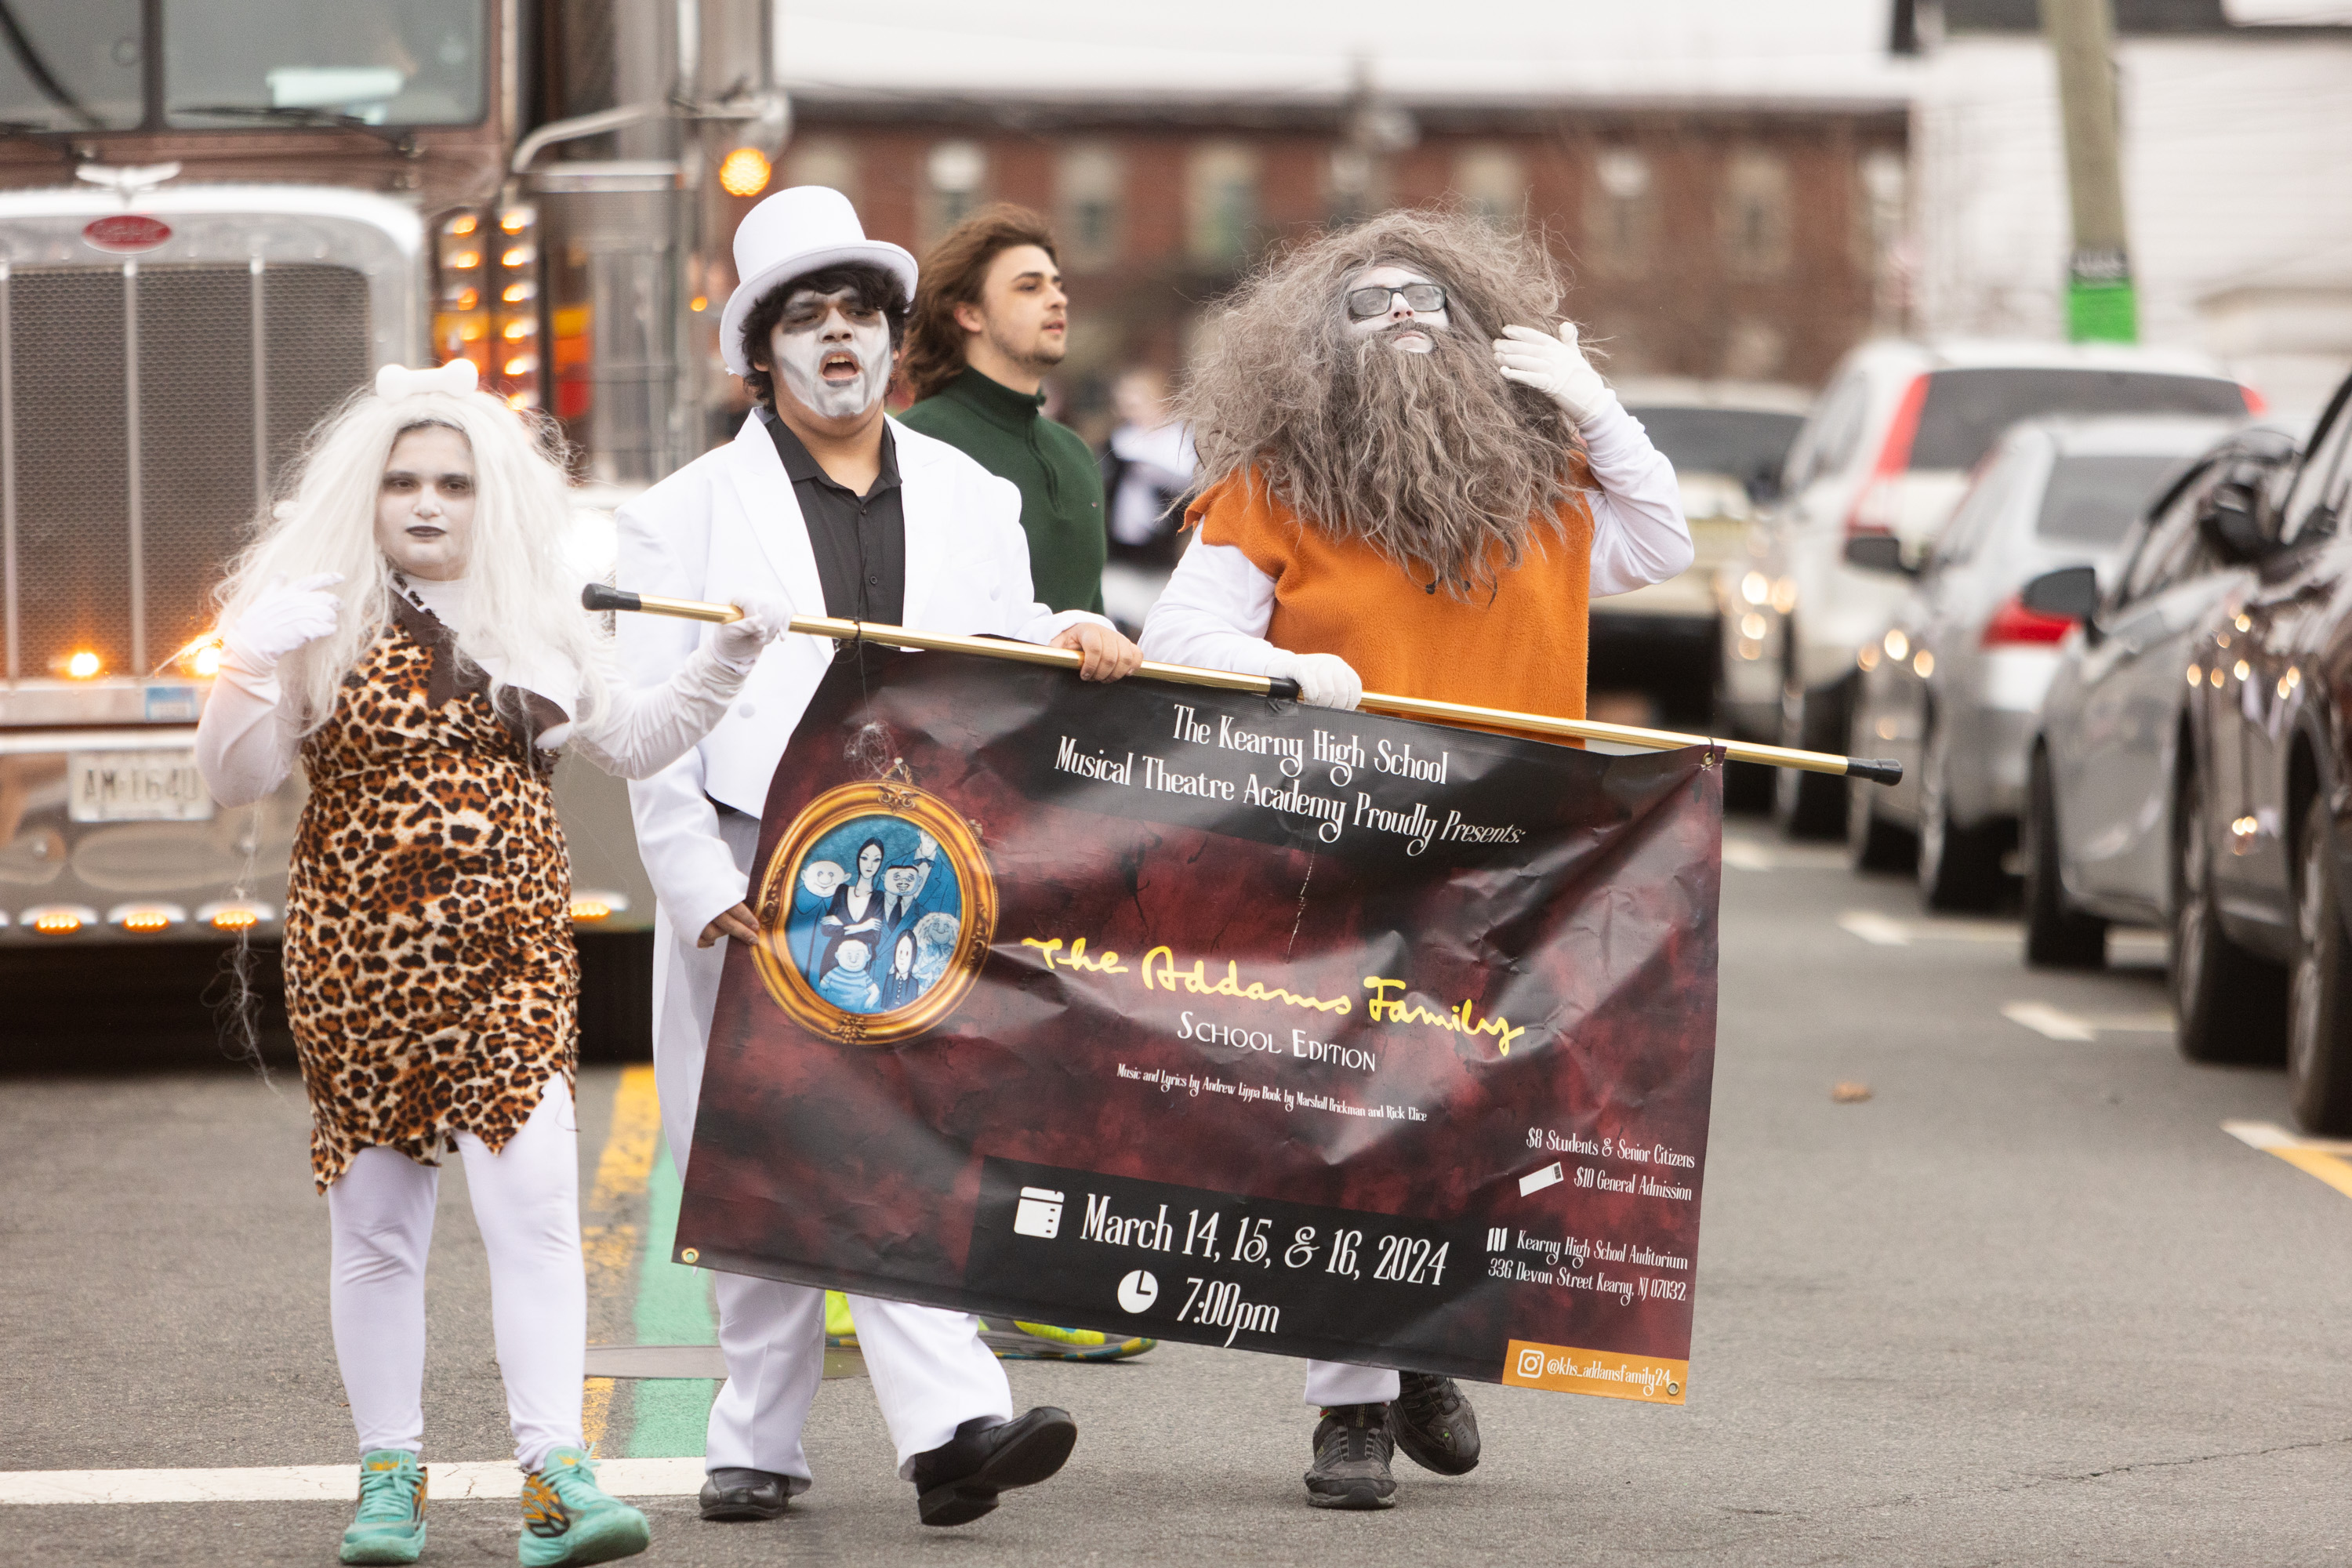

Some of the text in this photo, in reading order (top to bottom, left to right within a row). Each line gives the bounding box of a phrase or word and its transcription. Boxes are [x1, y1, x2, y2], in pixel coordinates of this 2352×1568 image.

[1173, 704, 1449, 786] The Kearny High School
[1054, 735, 1526, 856] Musical Theatre Academy Proudly Presents:
[1022, 937, 1525, 1056] The Addams Family
[1116, 1063, 1427, 1122] Music and Lyrics by Andrew Lippa Book by Marshall Brickman and Rick Elice
[1526, 1127, 1695, 1169] $8 Students & Senior Citizens
[1573, 1166, 1692, 1201] $10 General Admission
[1080, 1193, 1450, 1286] March 14, 15, & 16, 2024
[1516, 1229, 1688, 1270] Kearny High School Auditorium
[1488, 1258, 1686, 1306] 336 Devon Street Kearny, NJ 07032
[1176, 1276, 1280, 1348] 7:00pm
[1546, 1356, 1671, 1397] @khs_addamsfamily24
